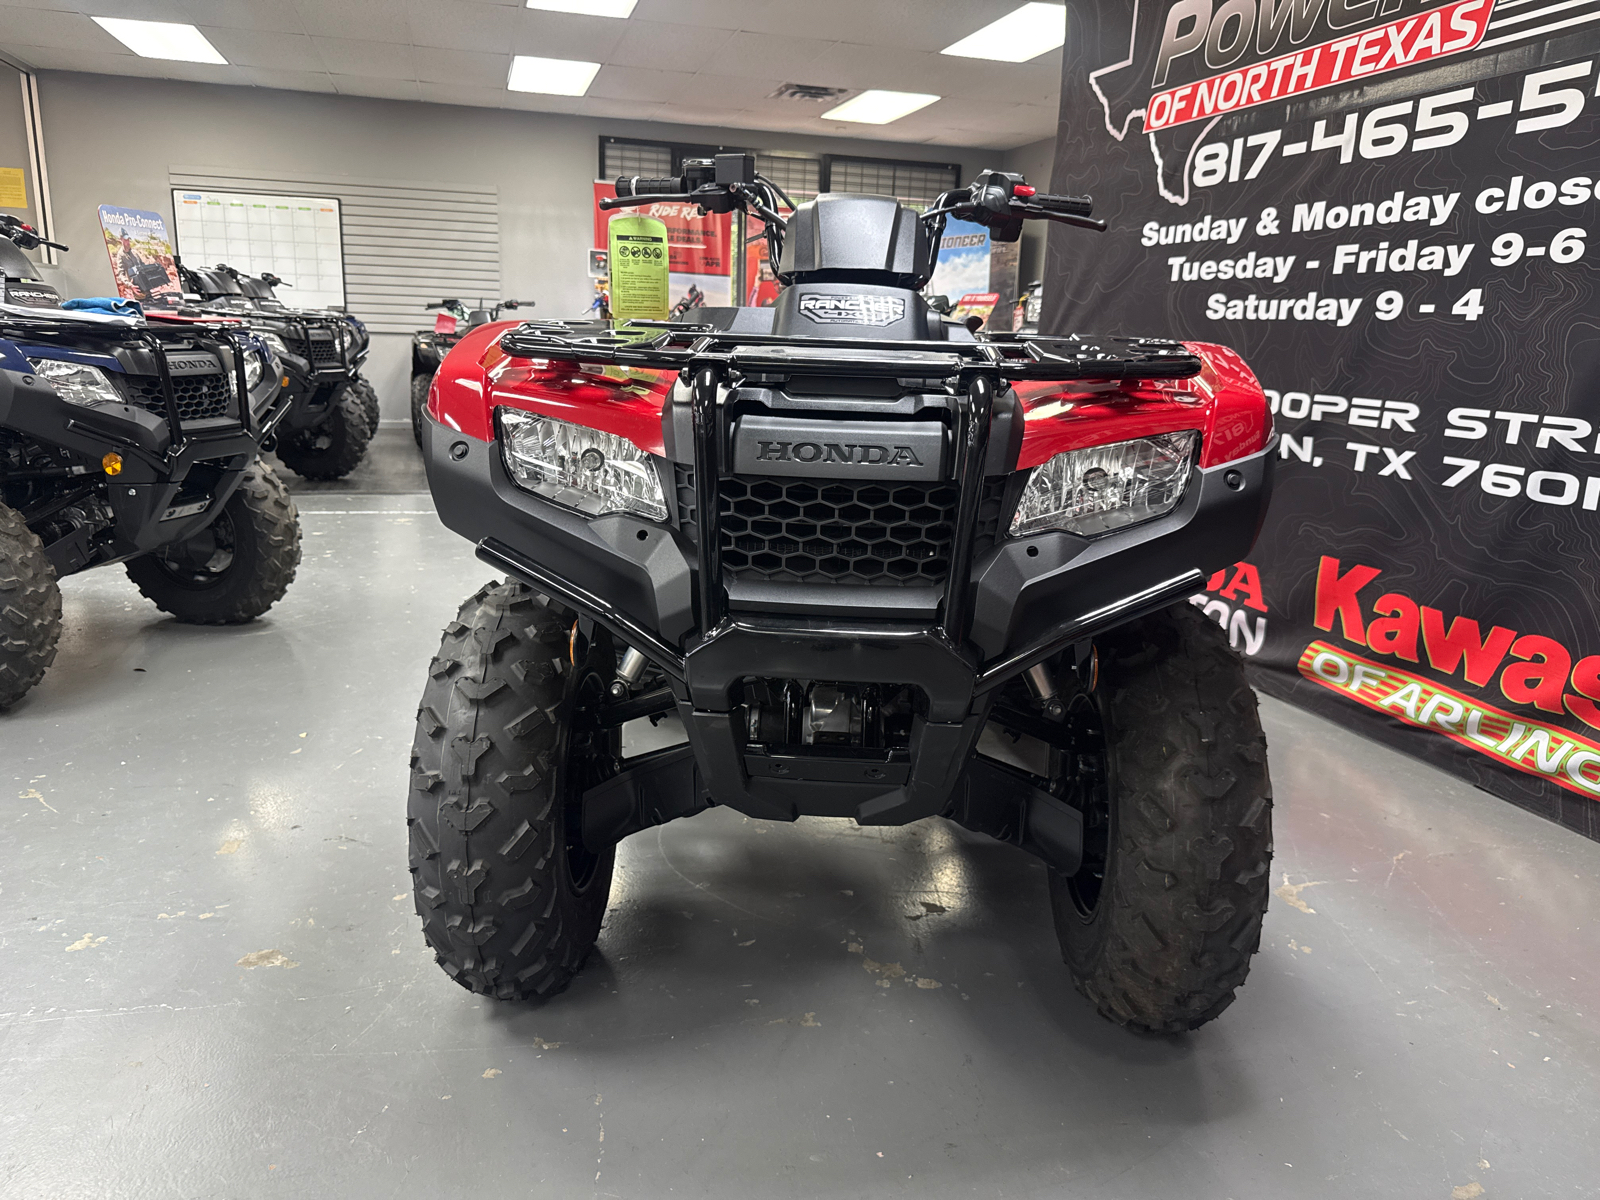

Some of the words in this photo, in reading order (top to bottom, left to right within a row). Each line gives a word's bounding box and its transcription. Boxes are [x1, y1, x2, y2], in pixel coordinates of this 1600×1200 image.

[1150, 89, 1192, 128] OF
[1192, 49, 1321, 117] NORTH
[1329, 1, 1486, 83] TEXAS
[1193, 60, 1600, 188] 817-465-5
[102, 210, 125, 226] Honda
[124, 213, 164, 231] Pro-Connect
[649, 204, 680, 218] RIDE
[1141, 212, 1247, 246] Sunday
[1256, 208, 1281, 236] &
[1292, 190, 1461, 232] Monday
[1475, 176, 1600, 215] clos
[1168, 252, 1296, 283] Tuesday
[1306, 260, 1319, 269] -
[1332, 239, 1473, 277] Friday
[1490, 227, 1588, 267] 9-6
[9, 291, 59, 300] RANCHER
[800, 299, 905, 315] RANCHER
[1205, 292, 1363, 326] Saturday
[1374, 290, 1404, 321] 9
[1418, 304, 1436, 314] -
[1451, 288, 1485, 321] 4
[168, 360, 217, 370] HONDA
[1443, 406, 1600, 455] STR
[756, 440, 924, 466] HONDA
[1346, 441, 1418, 481] TX
[1311, 650, 1386, 692] OF
